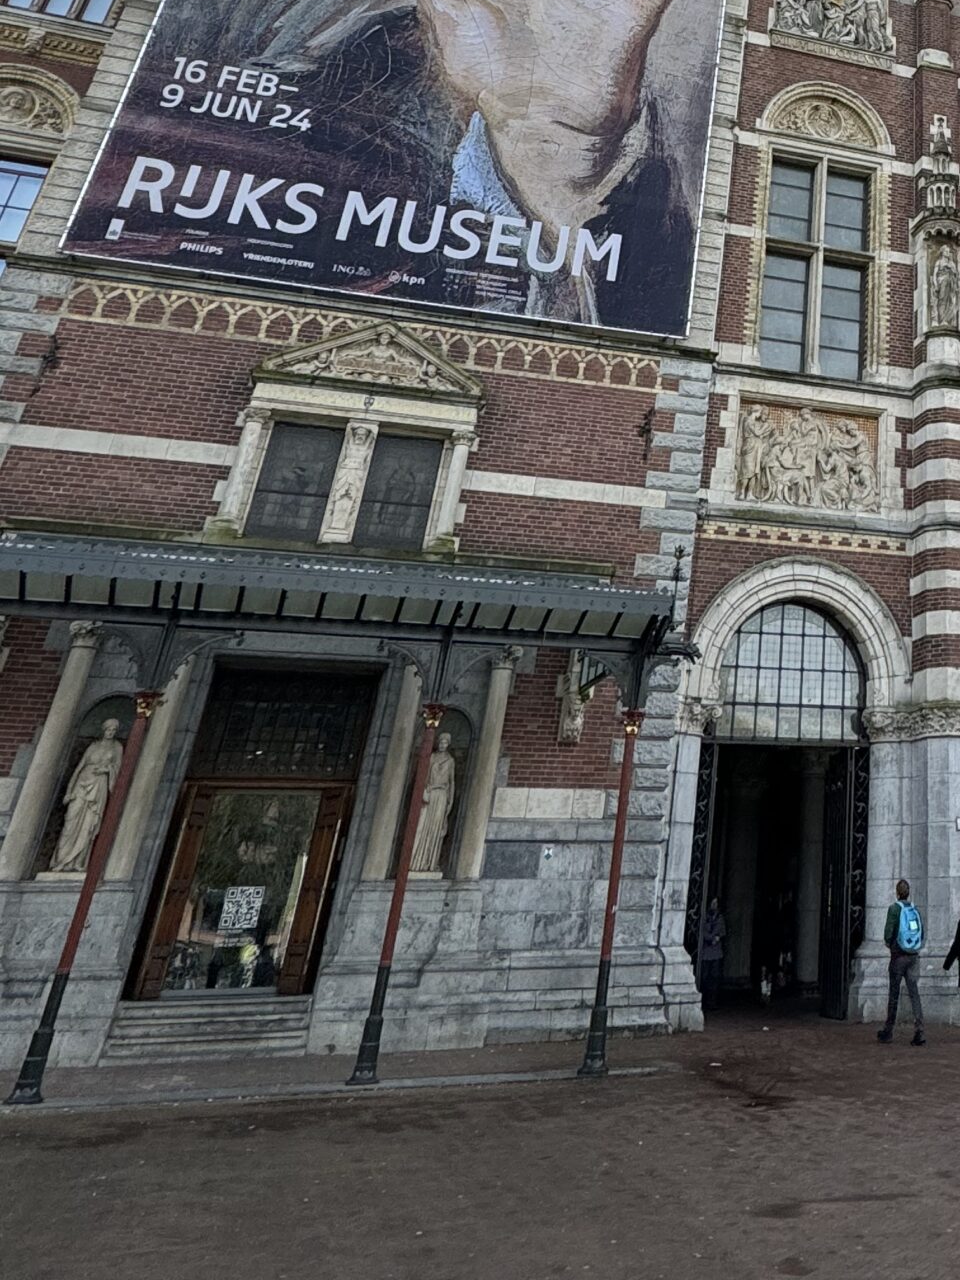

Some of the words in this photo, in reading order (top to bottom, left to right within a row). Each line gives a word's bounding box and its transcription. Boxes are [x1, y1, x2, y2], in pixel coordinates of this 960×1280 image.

[174, 56, 208, 83] 16
[159, 83, 185, 108] 9
[189, 91, 263, 123] JUN
[269, 104, 312, 131] 24
[117, 156, 325, 234] RIJKS
[335, 191, 623, 282] MUSEUM
[180, 241, 224, 255] PHILIPS
[332, 263, 355, 274] ING
[402, 273, 426, 286] kpn
